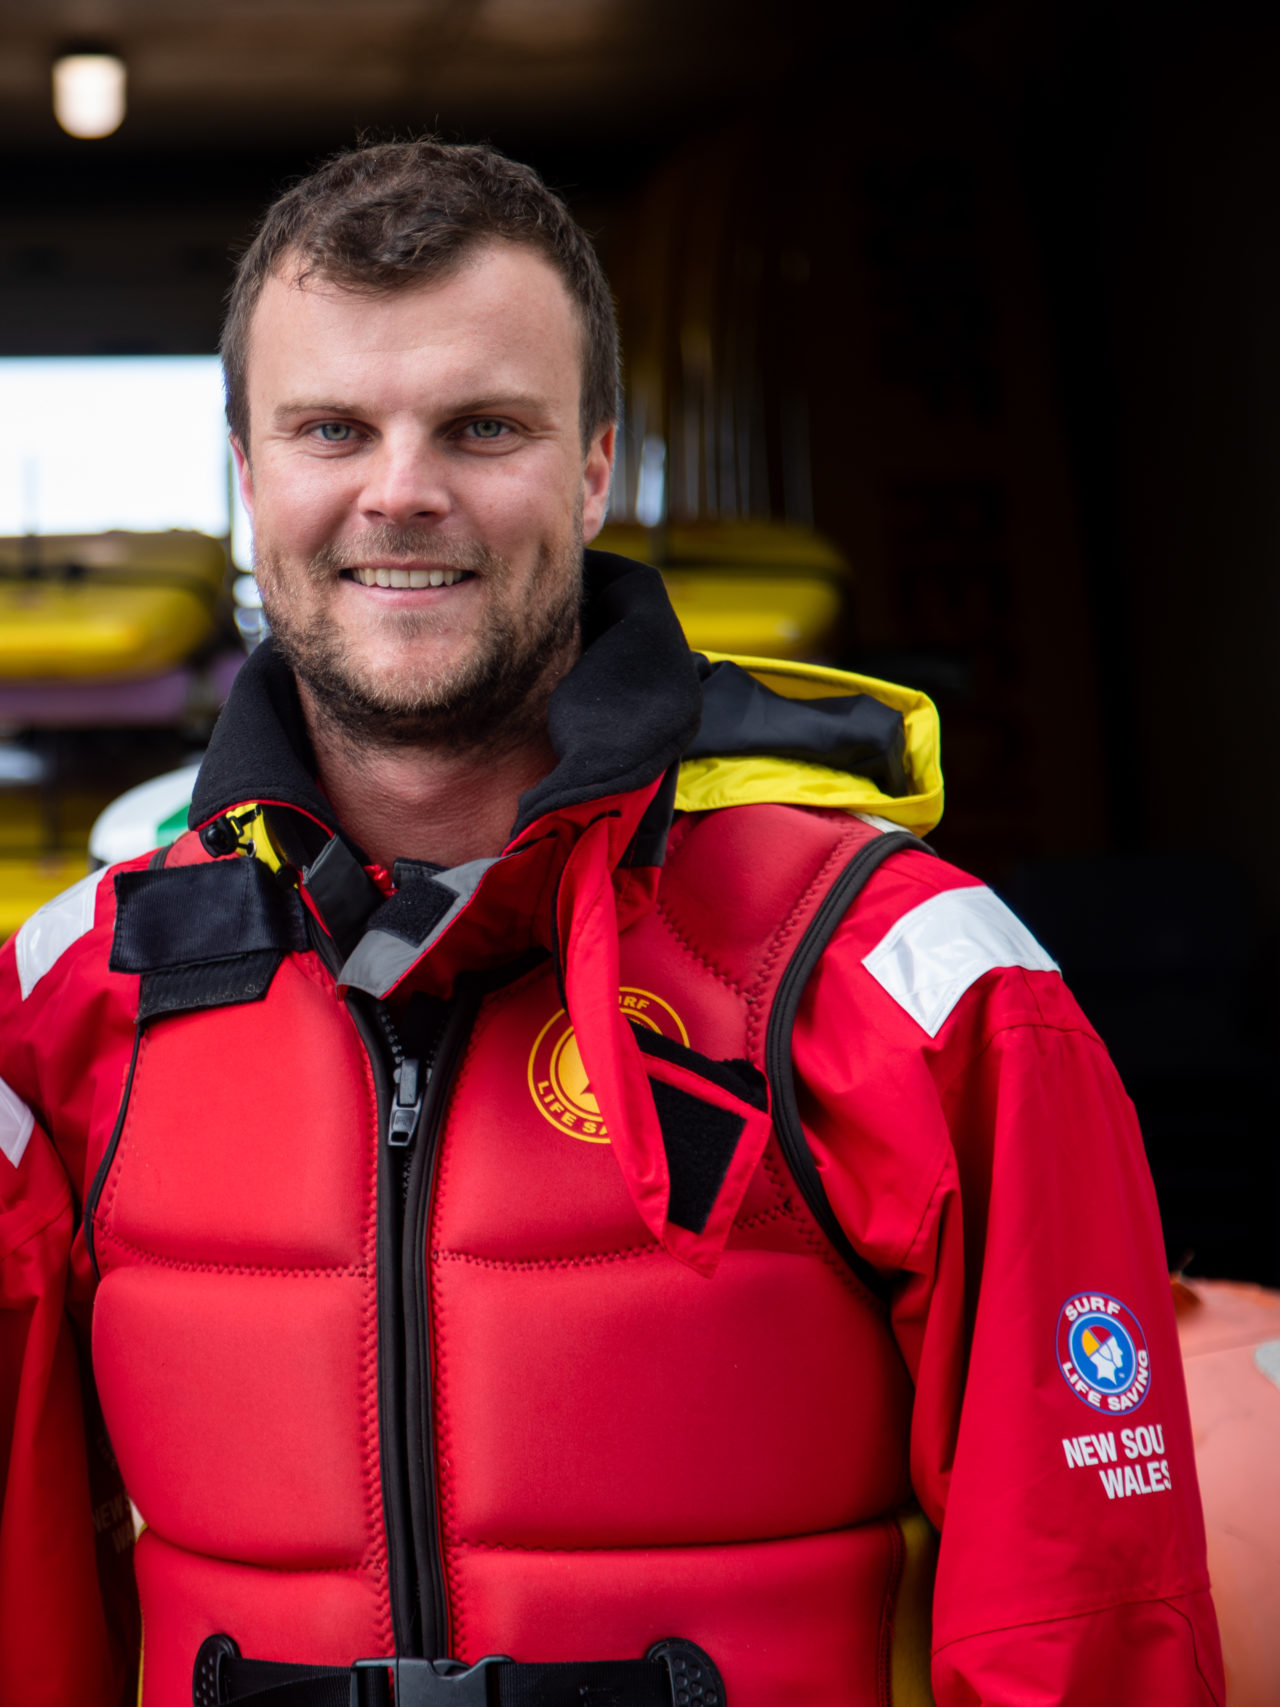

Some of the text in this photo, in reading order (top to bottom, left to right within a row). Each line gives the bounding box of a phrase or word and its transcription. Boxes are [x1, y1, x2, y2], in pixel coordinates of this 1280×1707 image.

[619, 995, 650, 1010] RF
[538, 1081, 577, 1126] LIFE
[1065, 1296, 1121, 1322] SURF
[1062, 1350, 1149, 1412] LIFE SAVING
[1062, 1423, 1166, 1469] NEW SOU
[1098, 1459, 1172, 1500] WALES
